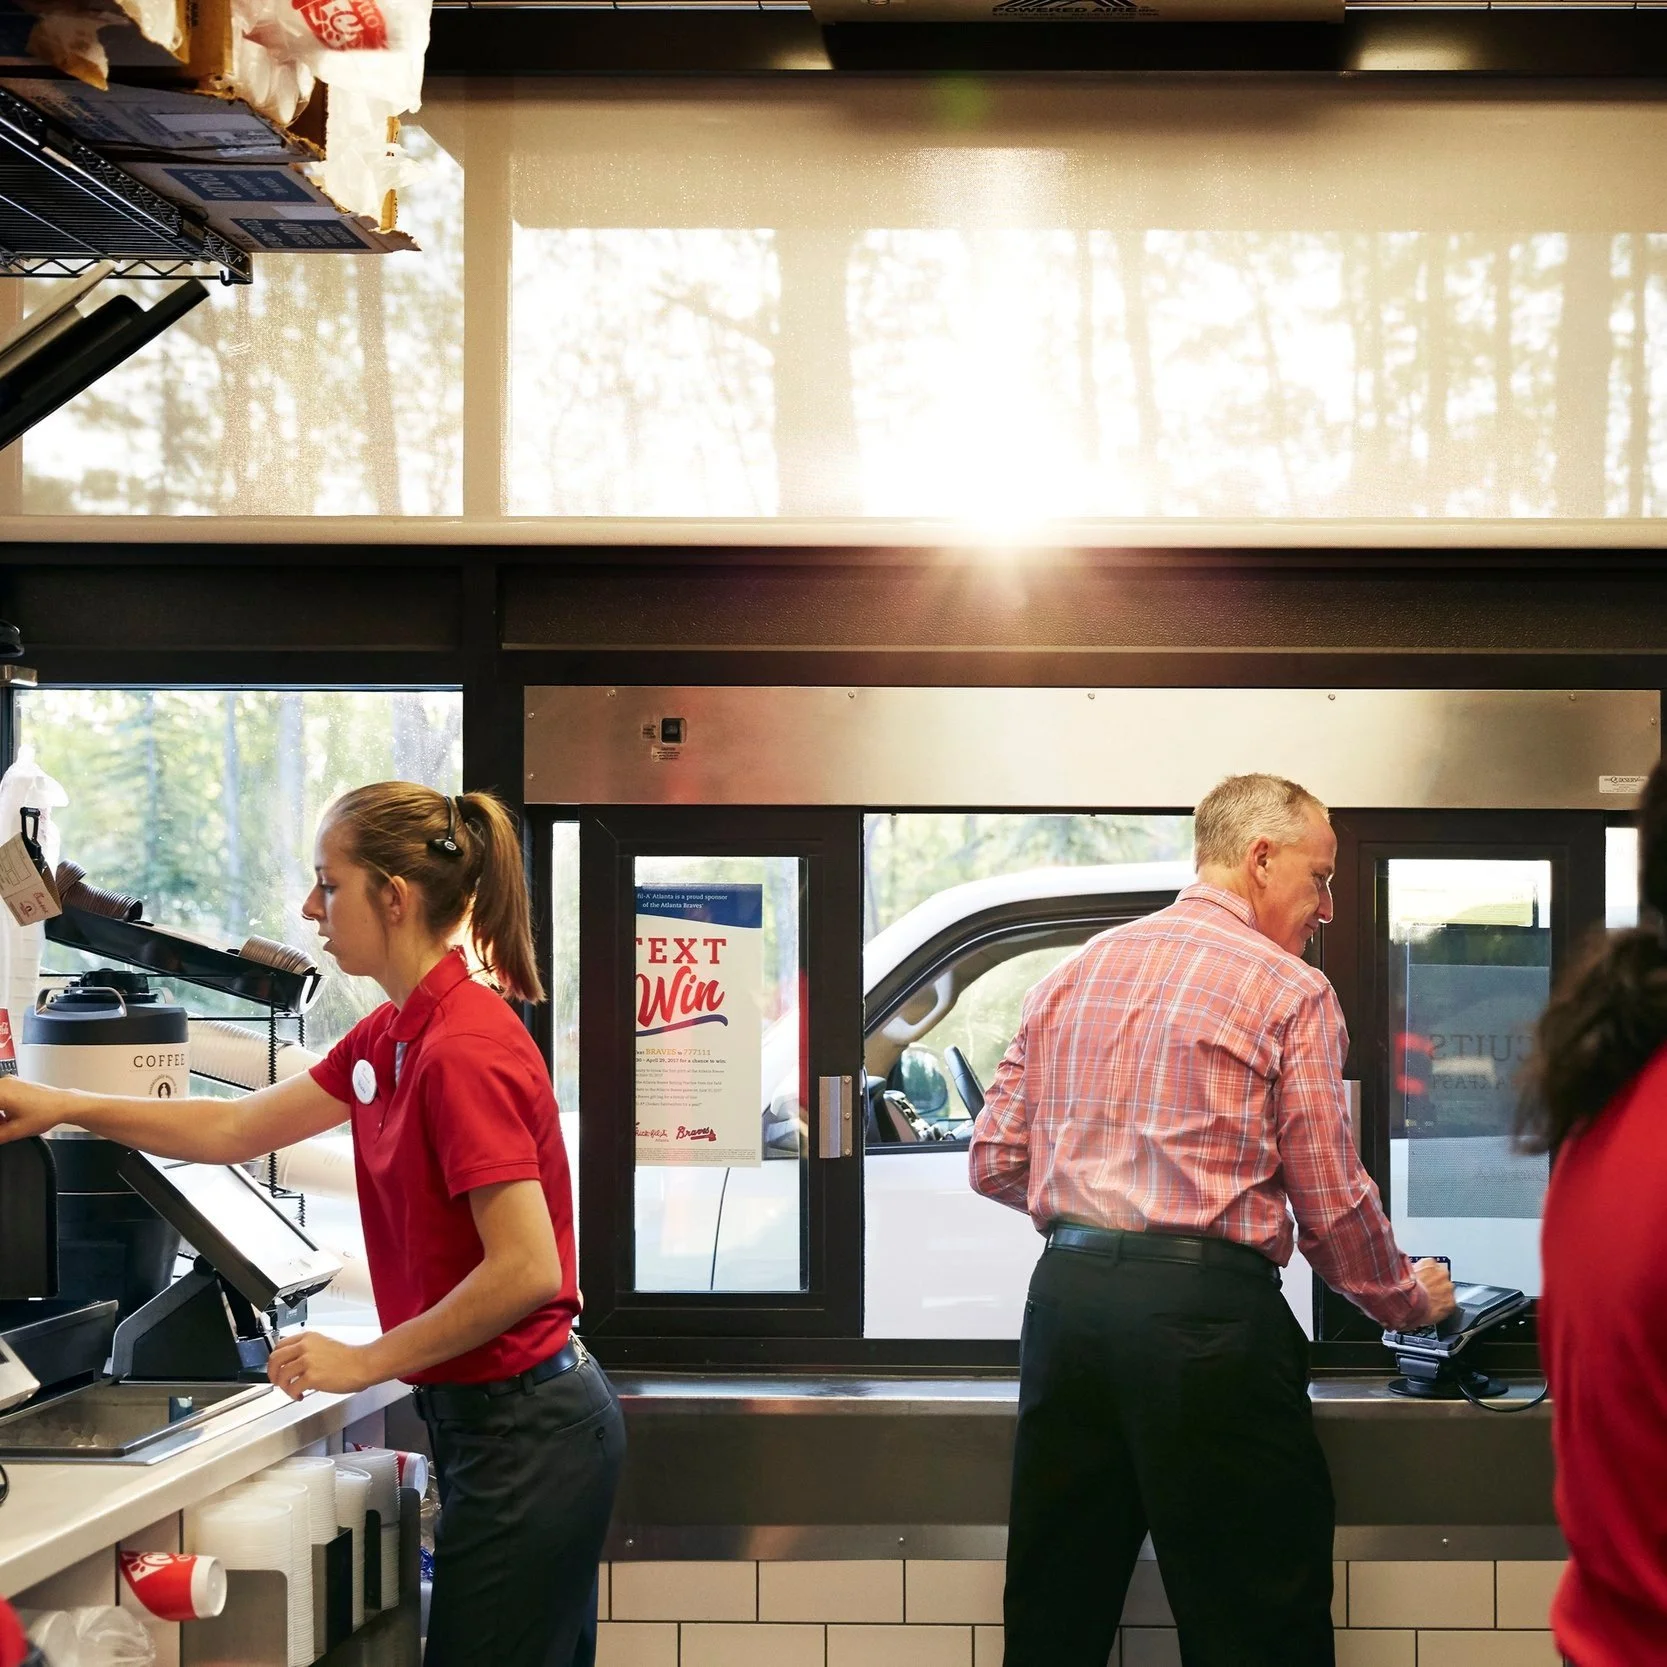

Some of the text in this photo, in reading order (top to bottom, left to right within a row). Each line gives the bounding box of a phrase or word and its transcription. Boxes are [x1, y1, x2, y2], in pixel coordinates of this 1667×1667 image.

[635, 966, 725, 1027] Win
[133, 1054, 185, 1068] COFFEE
[676, 1126, 710, 1140] Braves
